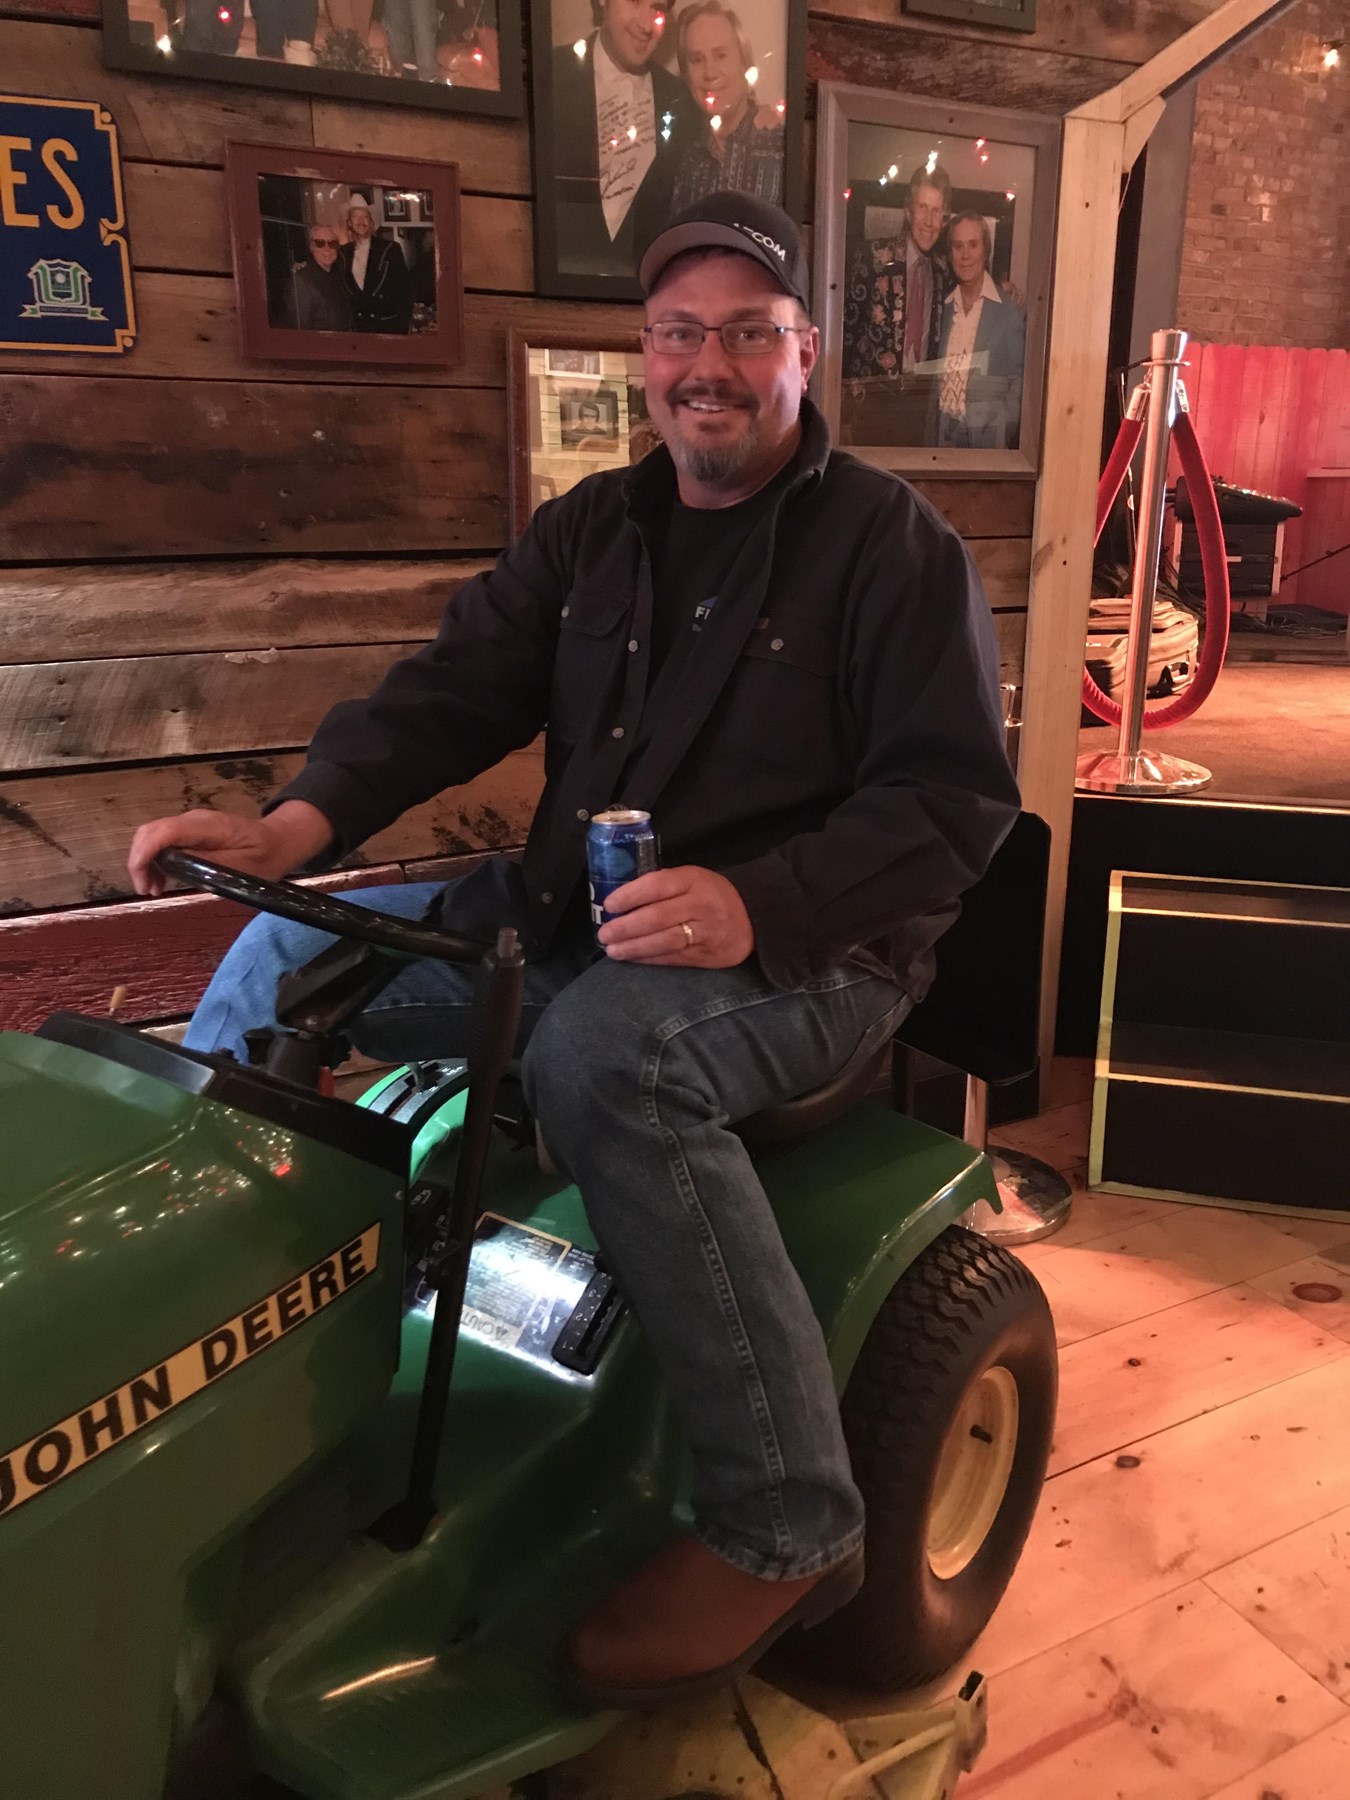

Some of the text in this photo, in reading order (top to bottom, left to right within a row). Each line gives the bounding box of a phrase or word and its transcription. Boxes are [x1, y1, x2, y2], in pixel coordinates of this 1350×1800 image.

[0, 135, 85, 229] ES
[733, 223, 786, 262] COM
[461, 1312, 496, 1336] CAUT
[0, 1364, 173, 1512] JOHN
[200, 1237, 367, 1381] DEERE
